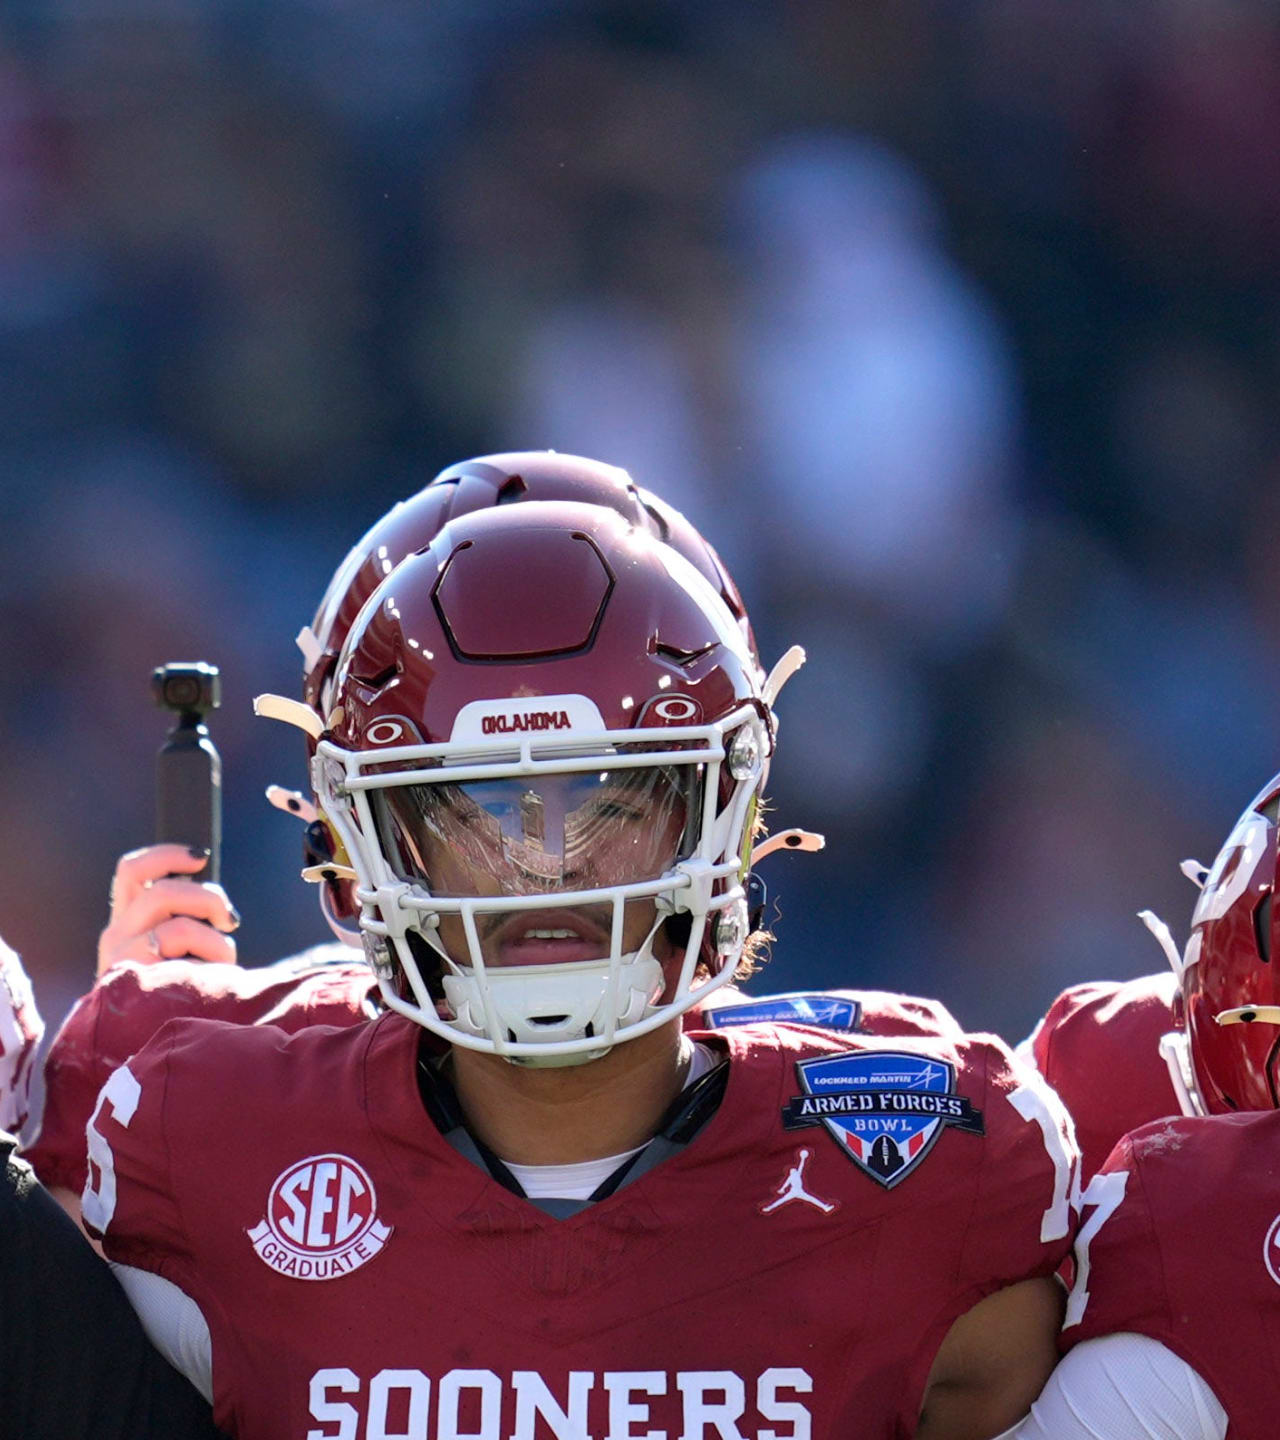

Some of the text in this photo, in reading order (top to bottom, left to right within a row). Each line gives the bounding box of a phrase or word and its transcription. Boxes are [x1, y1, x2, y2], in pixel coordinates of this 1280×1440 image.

[481, 710, 572, 735] OKLAHOMA
[814, 1075, 912, 1085] LOCKHEED MARTIN
[800, 1093, 963, 1116] ARMED FORCES
[855, 1119, 913, 1131] BOWL
[1006, 1085, 1082, 1243] 1
[278, 1161, 366, 1248] SEC
[261, 1242, 372, 1279] GRADUATE
